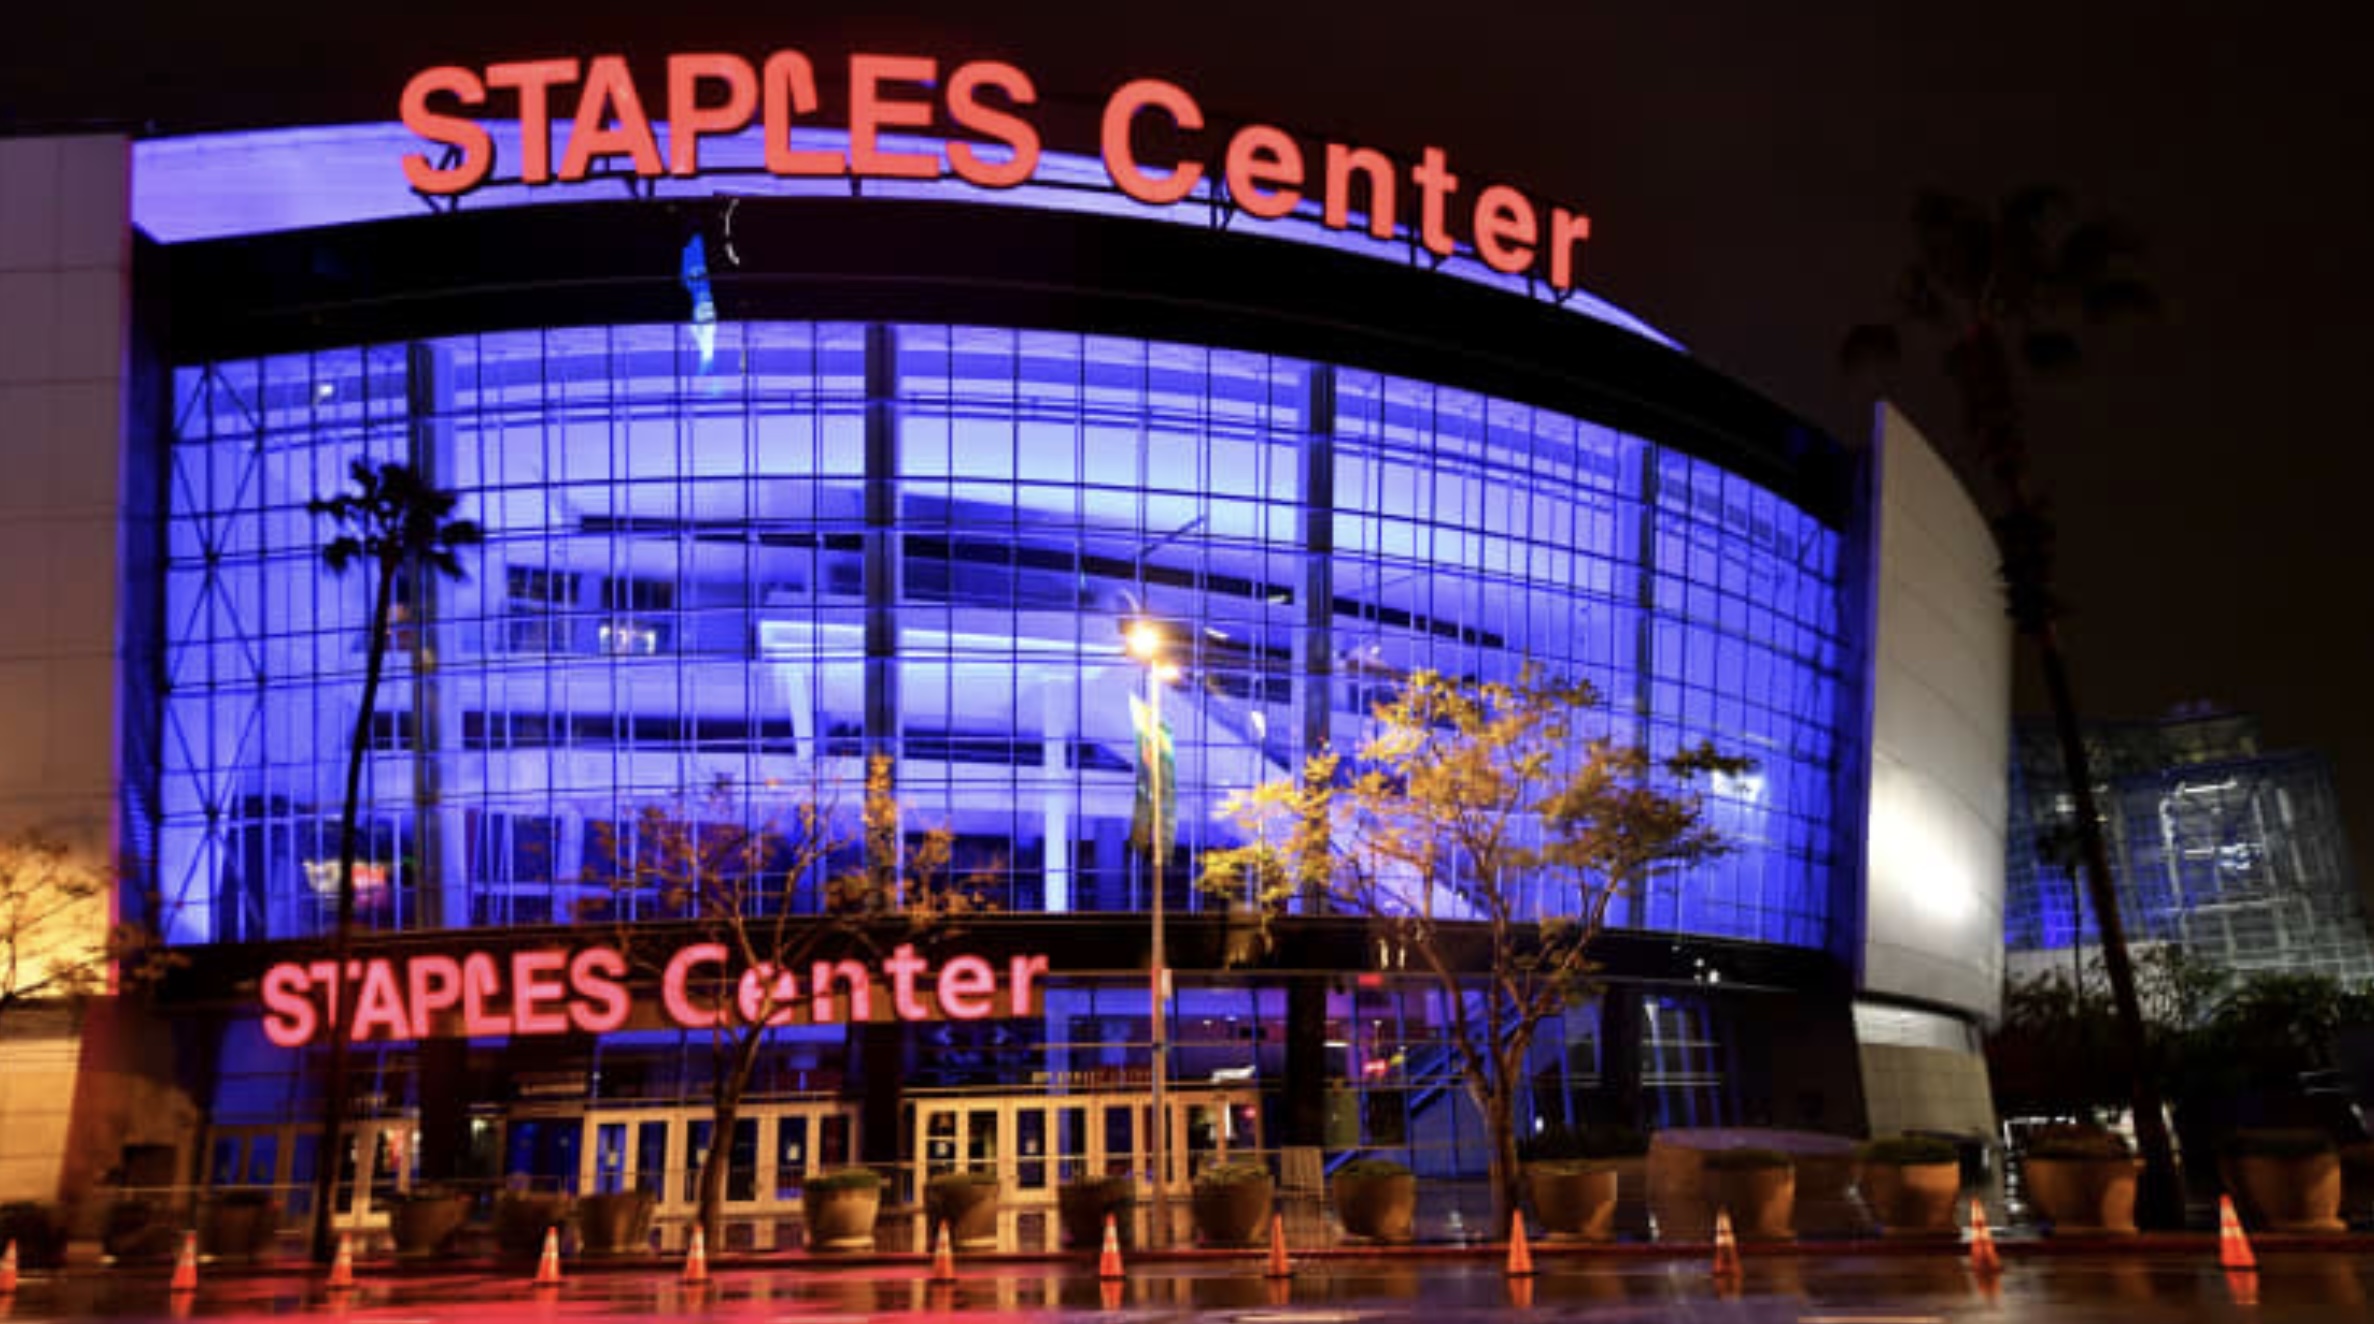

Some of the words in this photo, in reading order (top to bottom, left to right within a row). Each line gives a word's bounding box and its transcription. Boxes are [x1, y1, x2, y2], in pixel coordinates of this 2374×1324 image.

[399, 50, 1041, 193] STAPLES
[1101, 79, 1590, 290] Center
[262, 947, 632, 1048] STAPLES
[662, 942, 1049, 1028] Center
